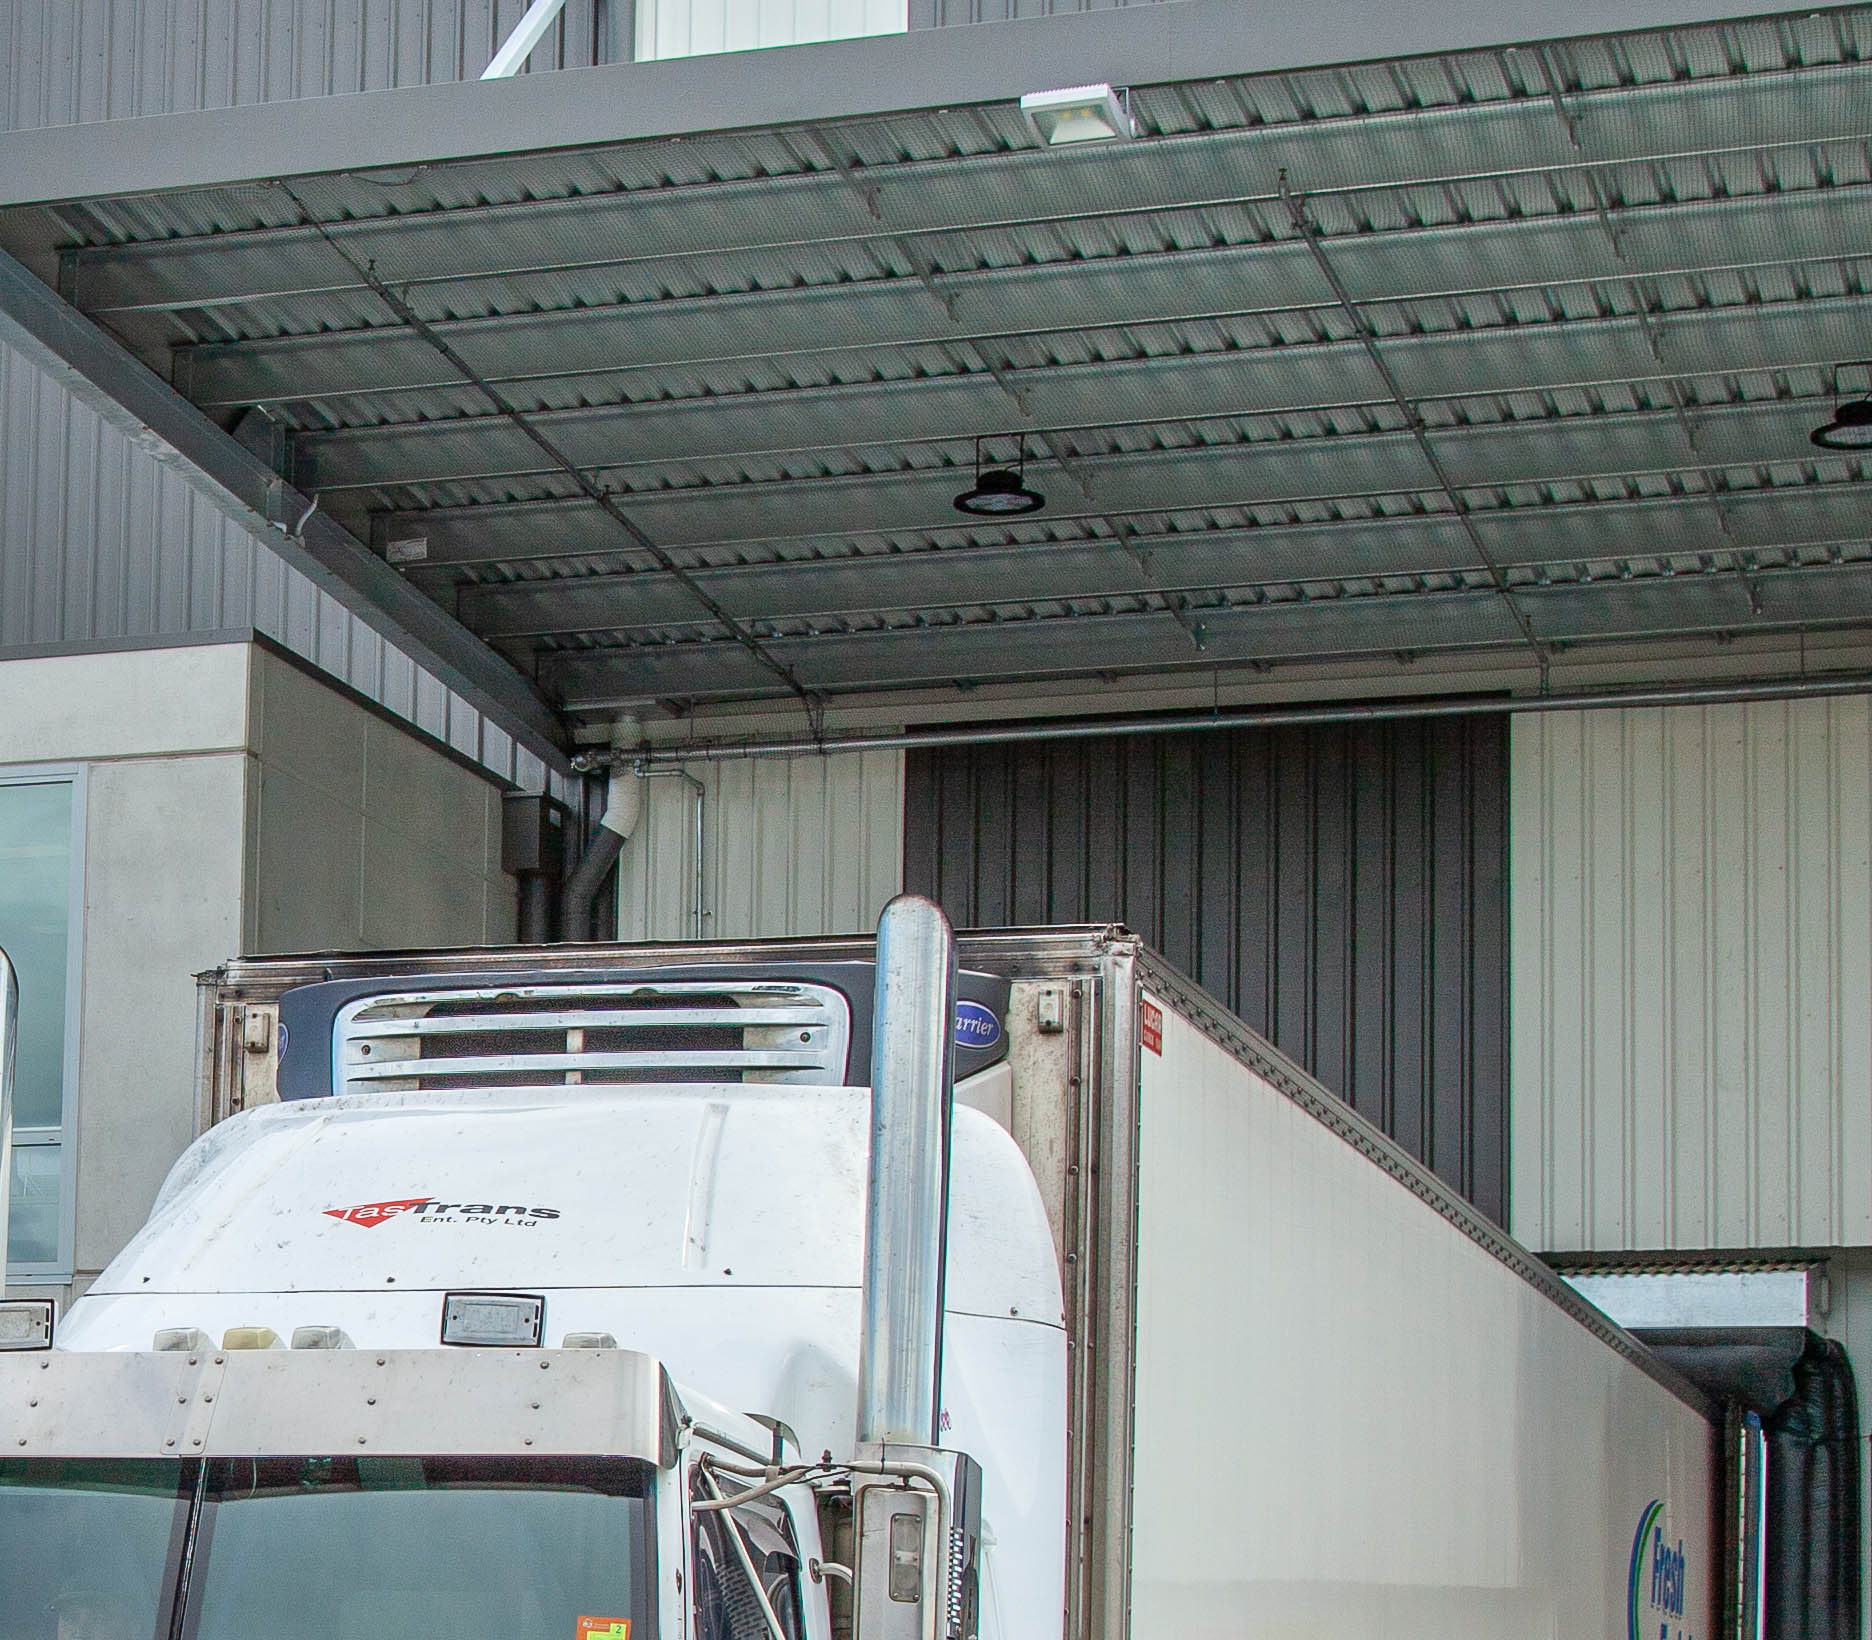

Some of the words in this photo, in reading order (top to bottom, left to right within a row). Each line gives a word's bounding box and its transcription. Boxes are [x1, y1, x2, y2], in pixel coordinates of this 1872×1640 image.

[956, 1016, 993, 1036] arrier
[420, 1216, 457, 1224] Ent.
[465, 1217, 497, 1225] Pty
[504, 1218, 538, 1227] Ltd
[1650, 1526, 1685, 1618] Fresh
